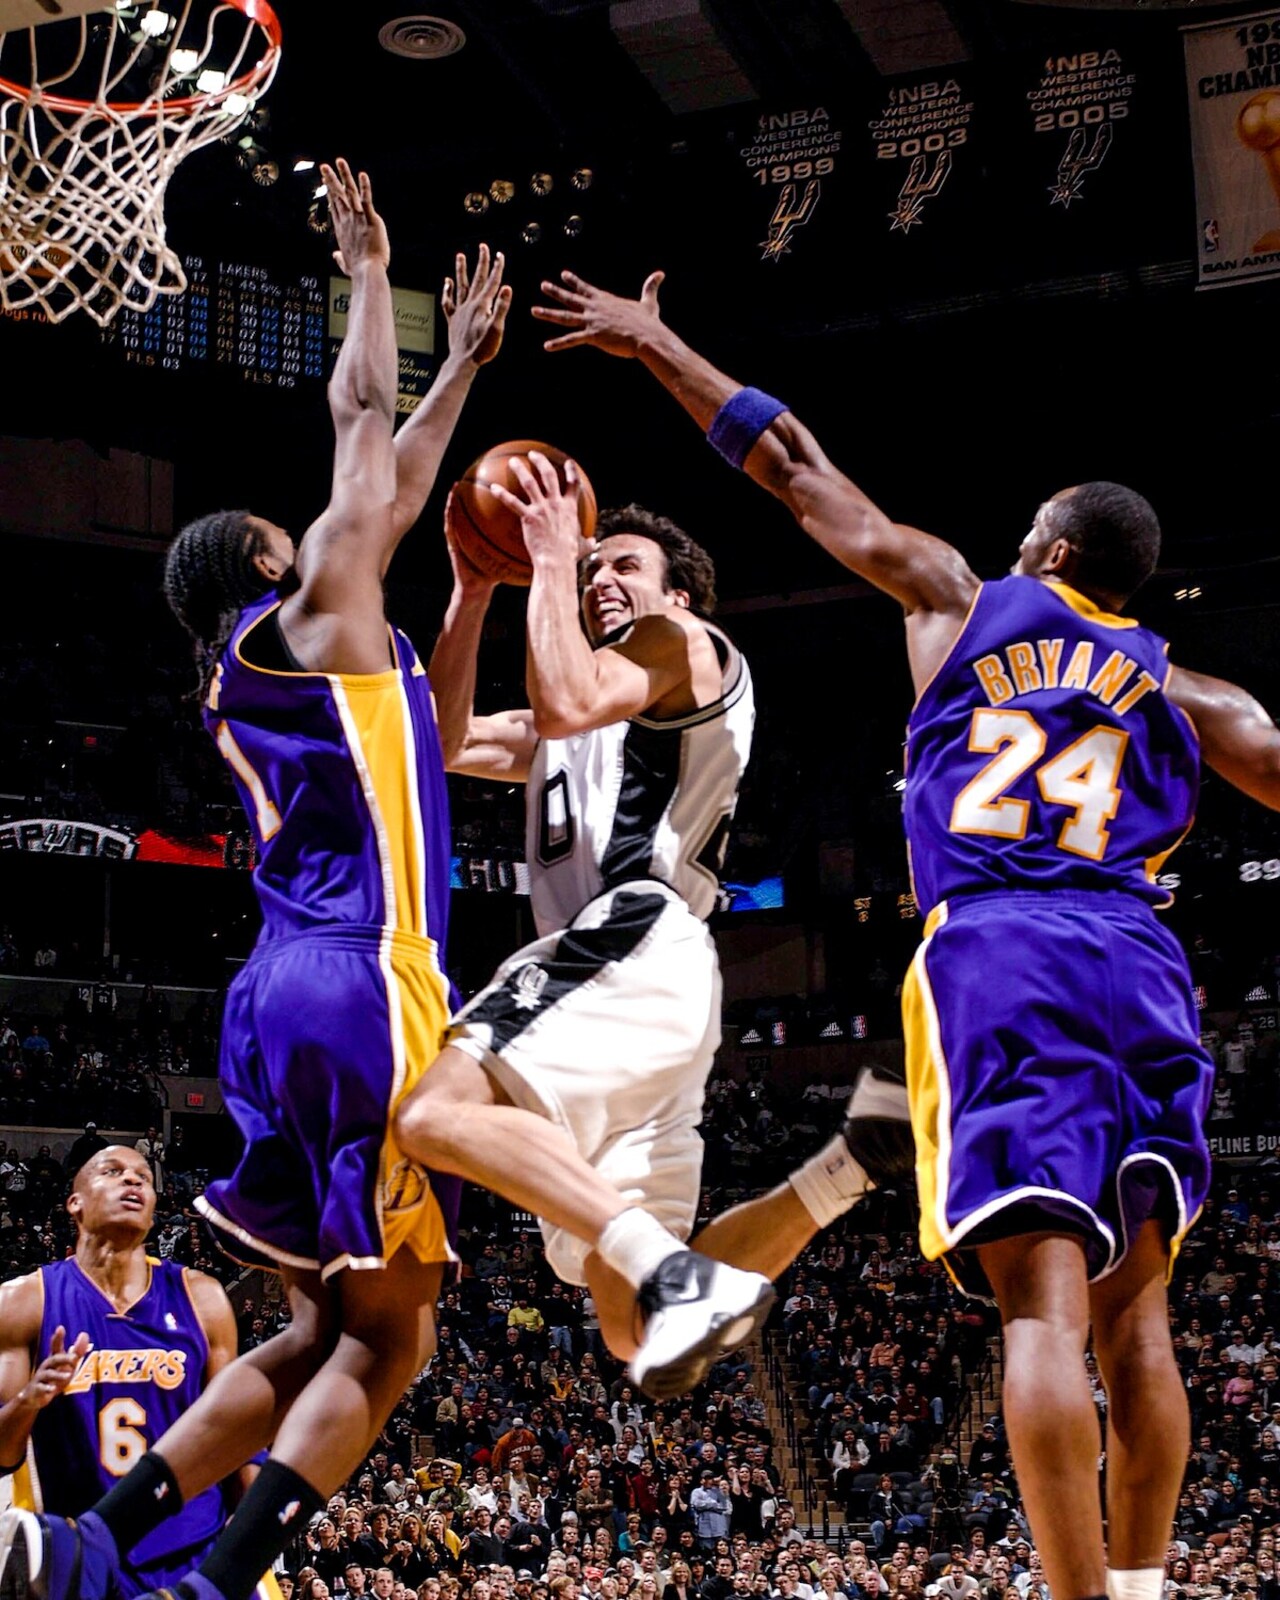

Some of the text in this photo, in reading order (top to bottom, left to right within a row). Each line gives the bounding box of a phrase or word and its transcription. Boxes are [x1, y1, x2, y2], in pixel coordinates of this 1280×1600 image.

[1057, 48, 1122, 73] NBA
[1026, 74, 1137, 100] CONFERENCE
[1039, 65, 1121, 87] WESTERN
[899, 79, 962, 105] NBA
[1030, 86, 1133, 112] CHAMPIONS
[768, 106, 830, 131] NBA
[868, 101, 975, 129] CONFERENCE
[882, 95, 960, 117] WESTERN
[1033, 100, 1130, 133] 2005
[753, 123, 829, 144] WESTERN
[872, 113, 971, 140] CHAMPIONS
[739, 131, 842, 158] CONFERENCE
[745, 143, 841, 168] CHAMPIONS
[876, 128, 968, 159] 2003
[752, 156, 835, 186] 1999
[219, 261, 268, 281] LAKERS
[1203, 260, 1237, 273] SAN
[972, 638, 1161, 716] BRYANT
[949, 707, 1131, 862] 24
[1238, 858, 1280, 883] 89
[1257, 1134, 1280, 1153] BU
[99, 1397, 148, 1477] 6
